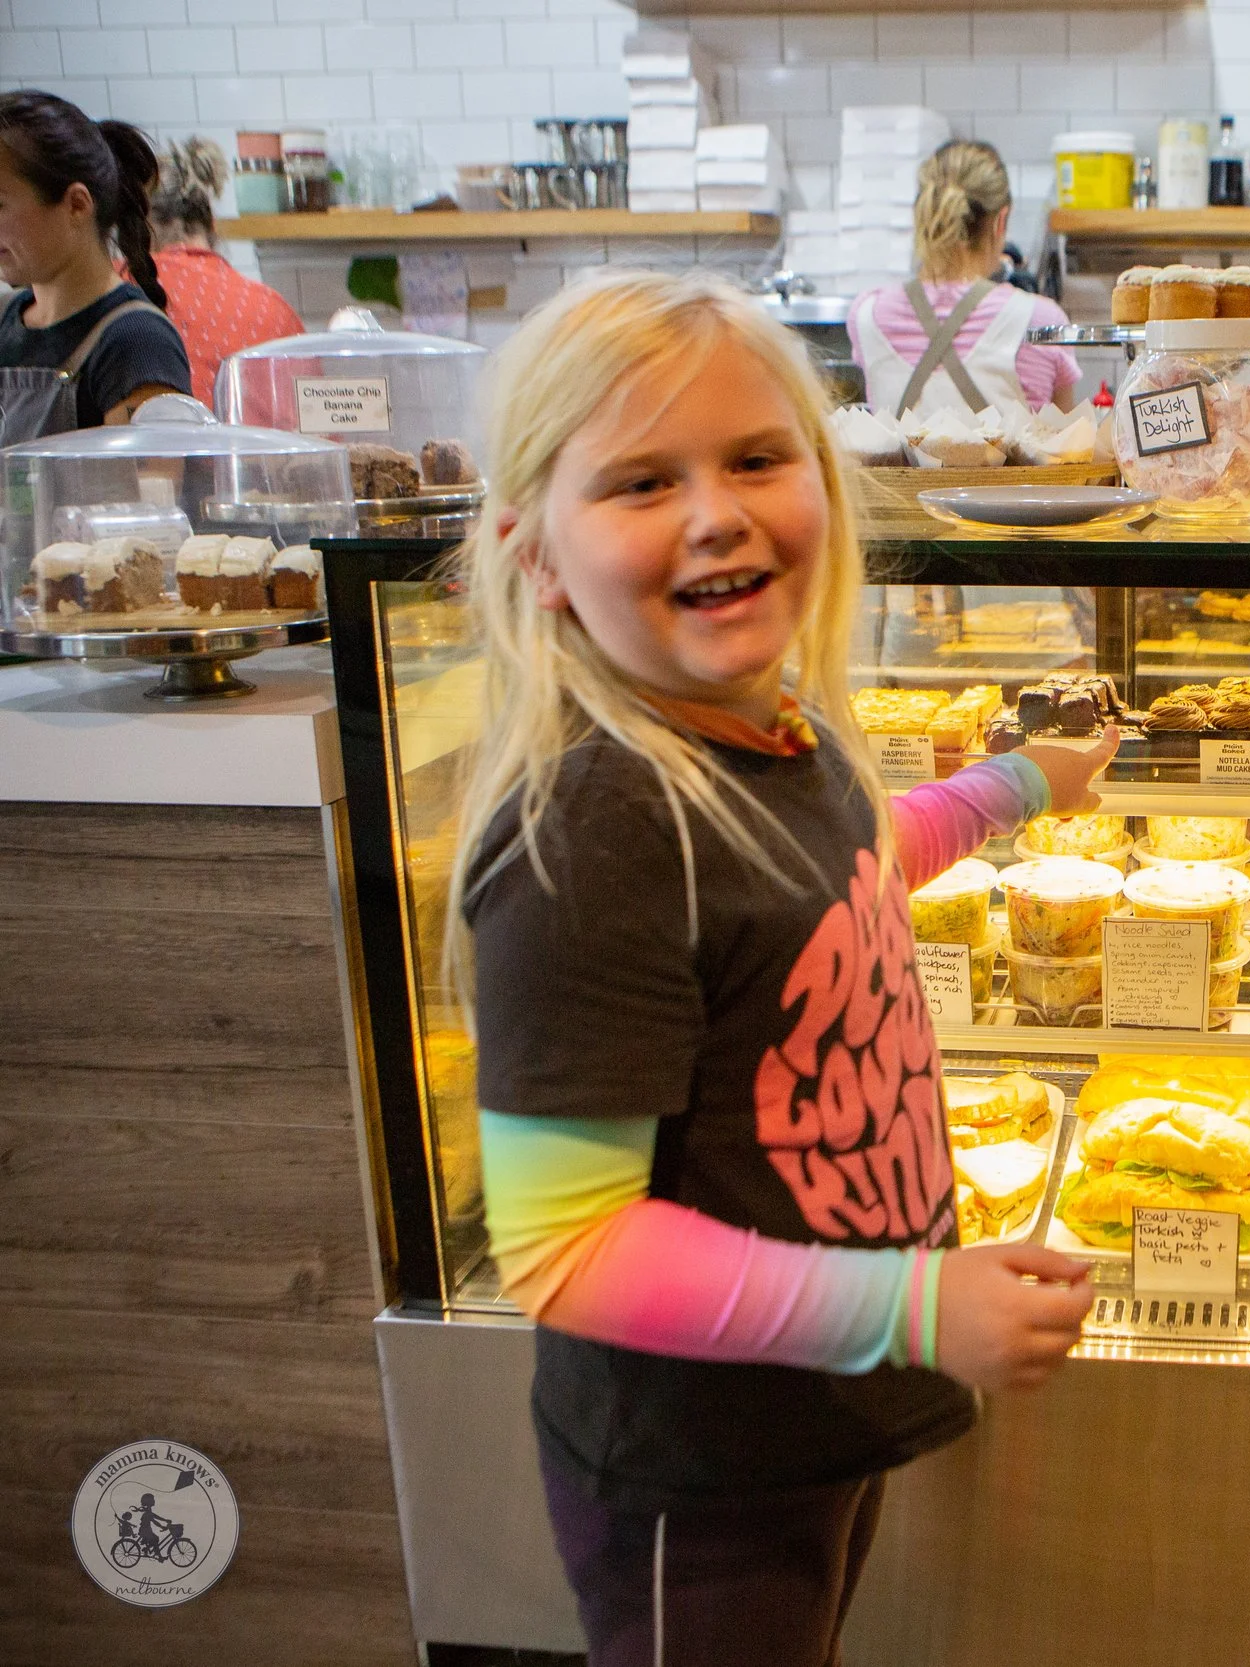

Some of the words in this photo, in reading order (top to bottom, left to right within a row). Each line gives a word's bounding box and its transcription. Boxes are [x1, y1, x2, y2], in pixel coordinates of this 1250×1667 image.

[303, 387, 354, 397] Chocolate
[357, 386, 381, 399] Chip
[324, 401, 363, 410] Banana
[1134, 396, 1191, 417] Turkish
[331, 413, 357, 423] Cake
[1143, 414, 1194, 443] Delight
[881, 750, 922, 758] RASPBERRY
[881, 758, 924, 766] FRANGIPANE
[1115, 924, 1153, 935] Noodle
[1158, 923, 1191, 937] Salad
[915, 945, 967, 958] auliflower
[916, 959, 959, 972] hickpeas,
[944, 985, 963, 993] rich
[1136, 1209, 1171, 1223] Roast
[1135, 1223, 1184, 1237] Turkish
[1139, 1237, 1171, 1249] basil
